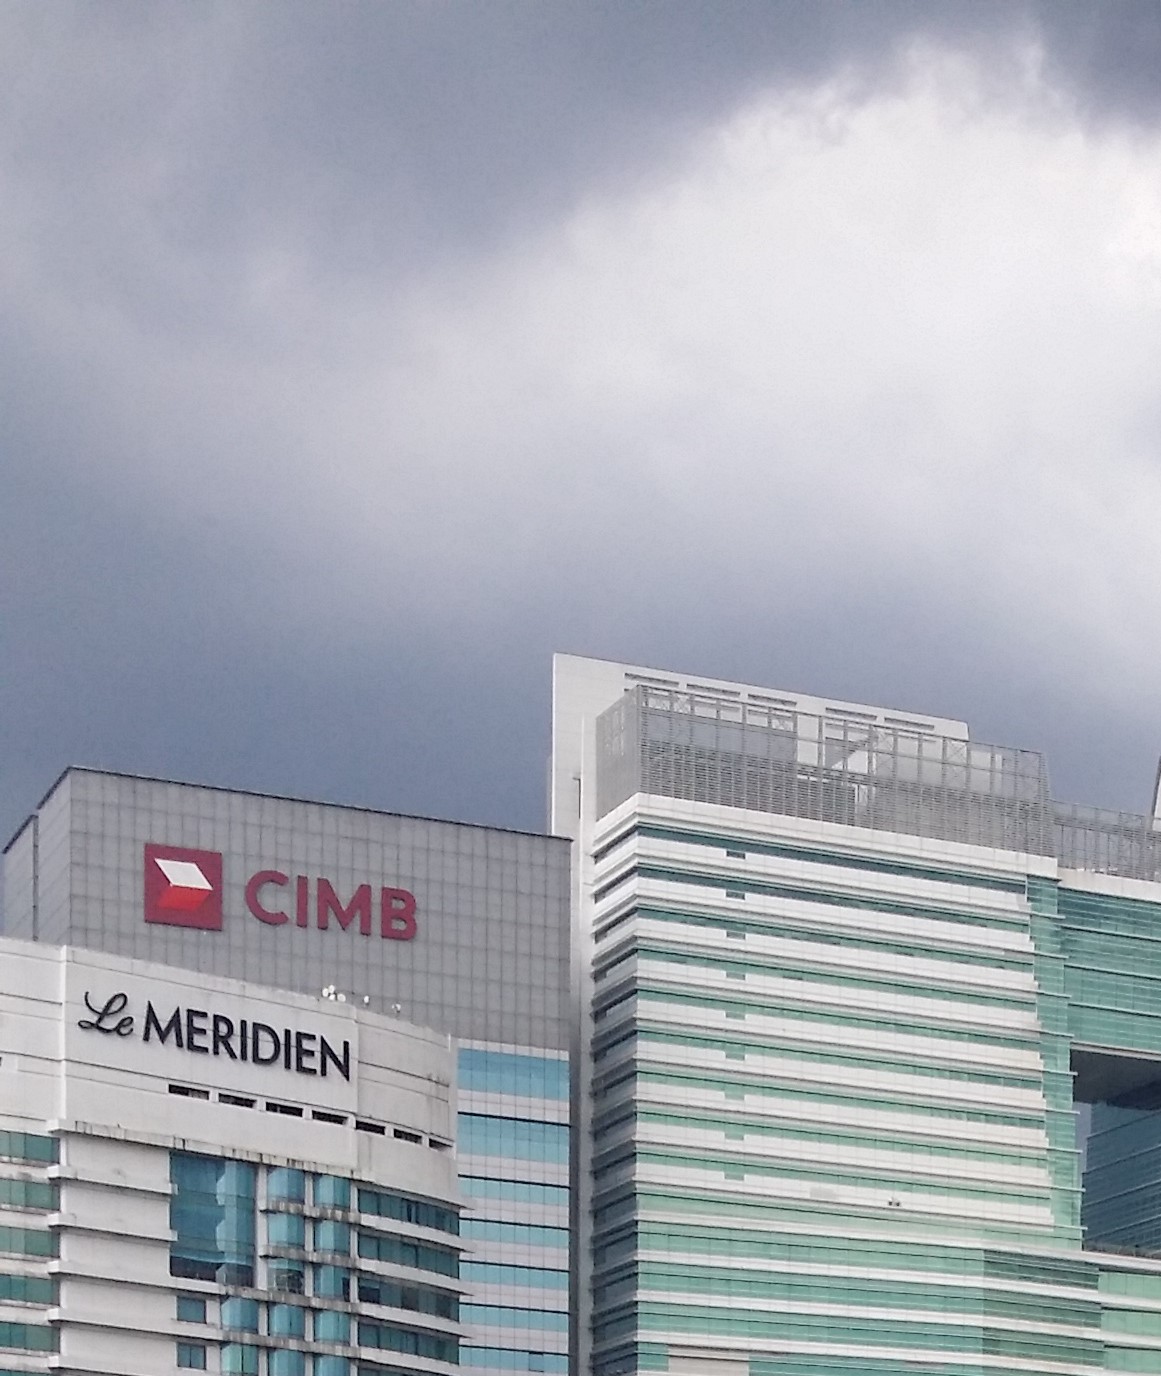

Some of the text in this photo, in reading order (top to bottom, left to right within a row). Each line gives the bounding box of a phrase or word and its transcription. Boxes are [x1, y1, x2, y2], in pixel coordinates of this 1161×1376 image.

[245, 870, 418, 941] CIMB
[78, 991, 350, 1082] Le MERIDIEN
